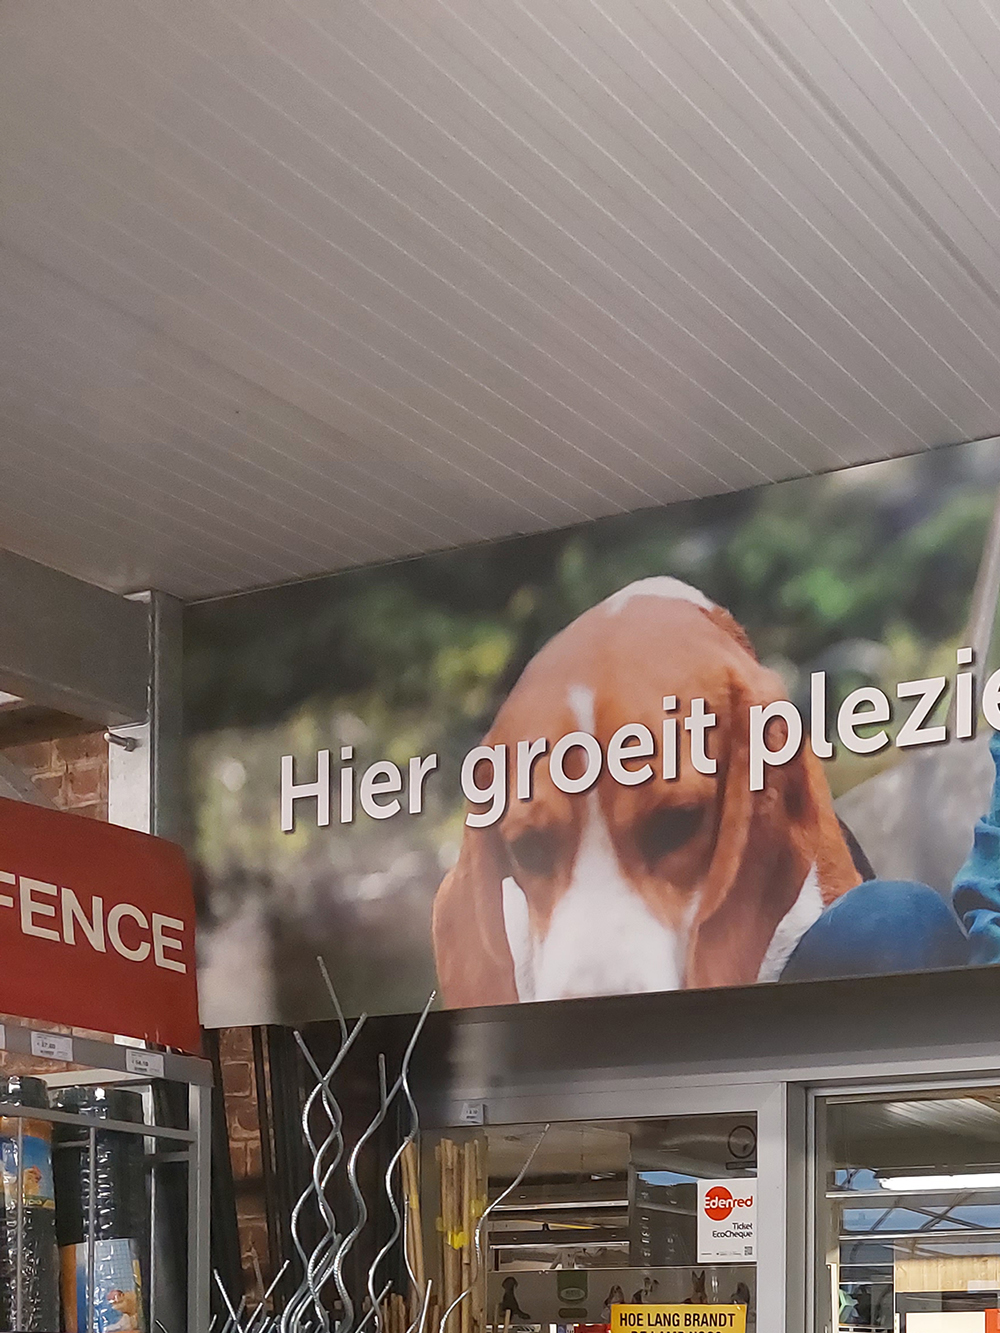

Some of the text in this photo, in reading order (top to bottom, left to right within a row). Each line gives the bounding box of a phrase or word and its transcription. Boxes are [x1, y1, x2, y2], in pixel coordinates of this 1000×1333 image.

[279, 748, 438, 832] Hier
[460, 695, 718, 828] groeit
[704, 1195, 753, 1209] Edenred
[732, 1222, 753, 1230] Ticket
[712, 1230, 753, 1239] EcoCheque
[620, 1313, 736, 1328] HOE LANG BRANDT
